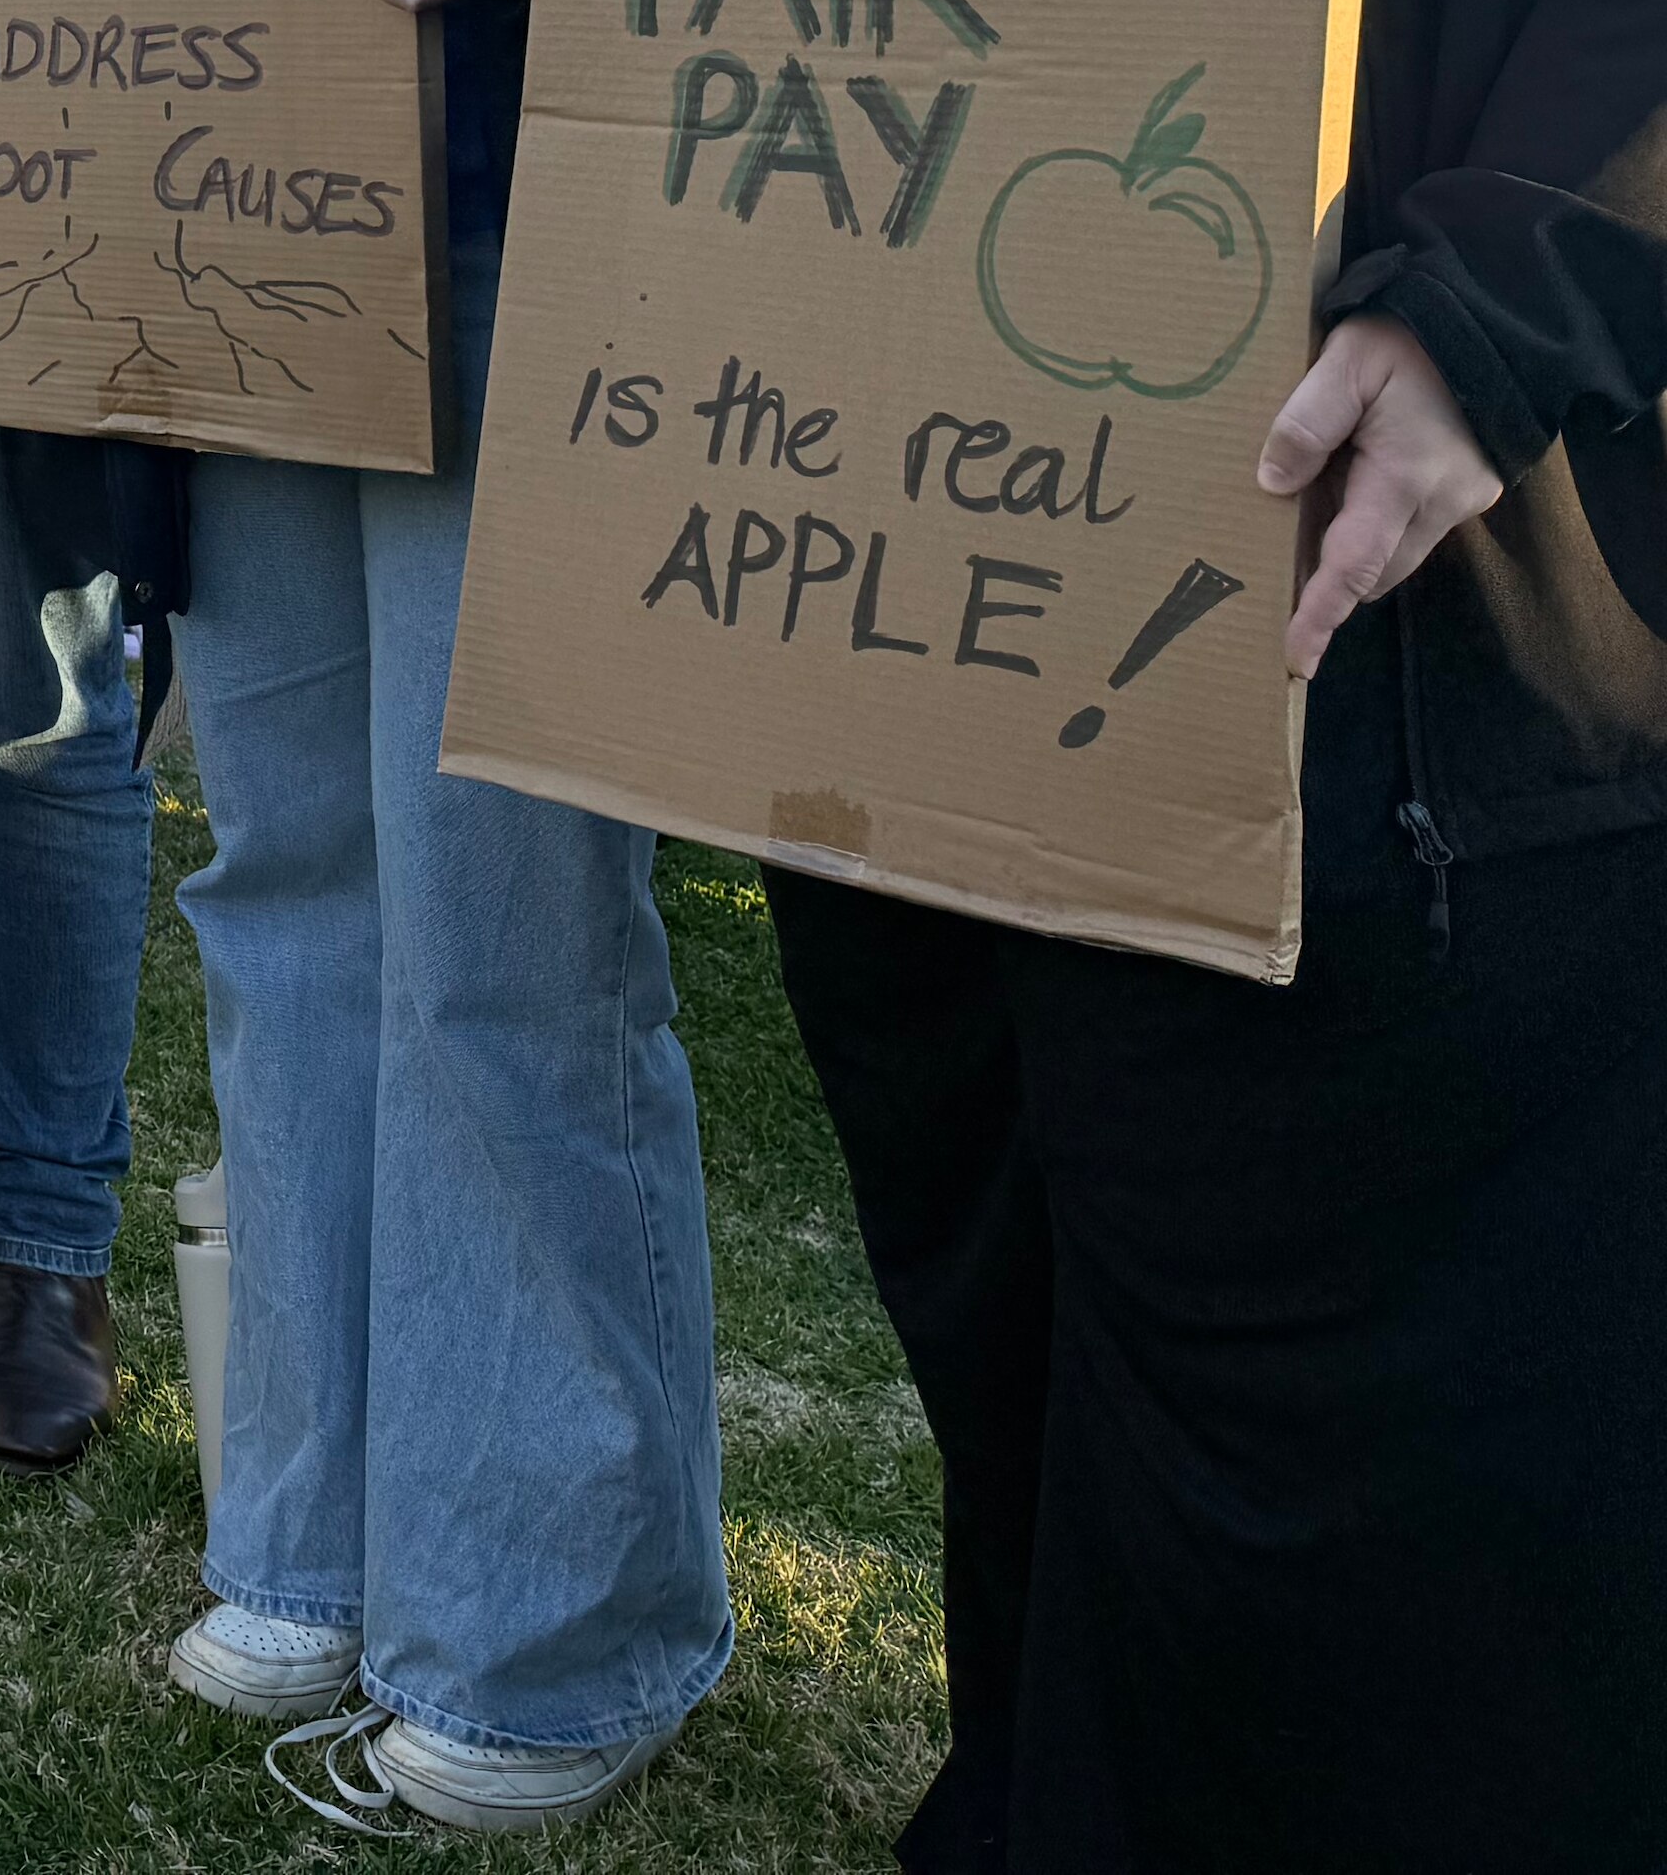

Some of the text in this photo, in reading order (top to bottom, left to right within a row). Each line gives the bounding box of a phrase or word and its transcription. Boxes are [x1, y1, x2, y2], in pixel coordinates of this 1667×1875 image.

[153, 124, 406, 239] CAUSES
[664, 50, 979, 250] PAY
[568, 341, 1138, 525] is the real
